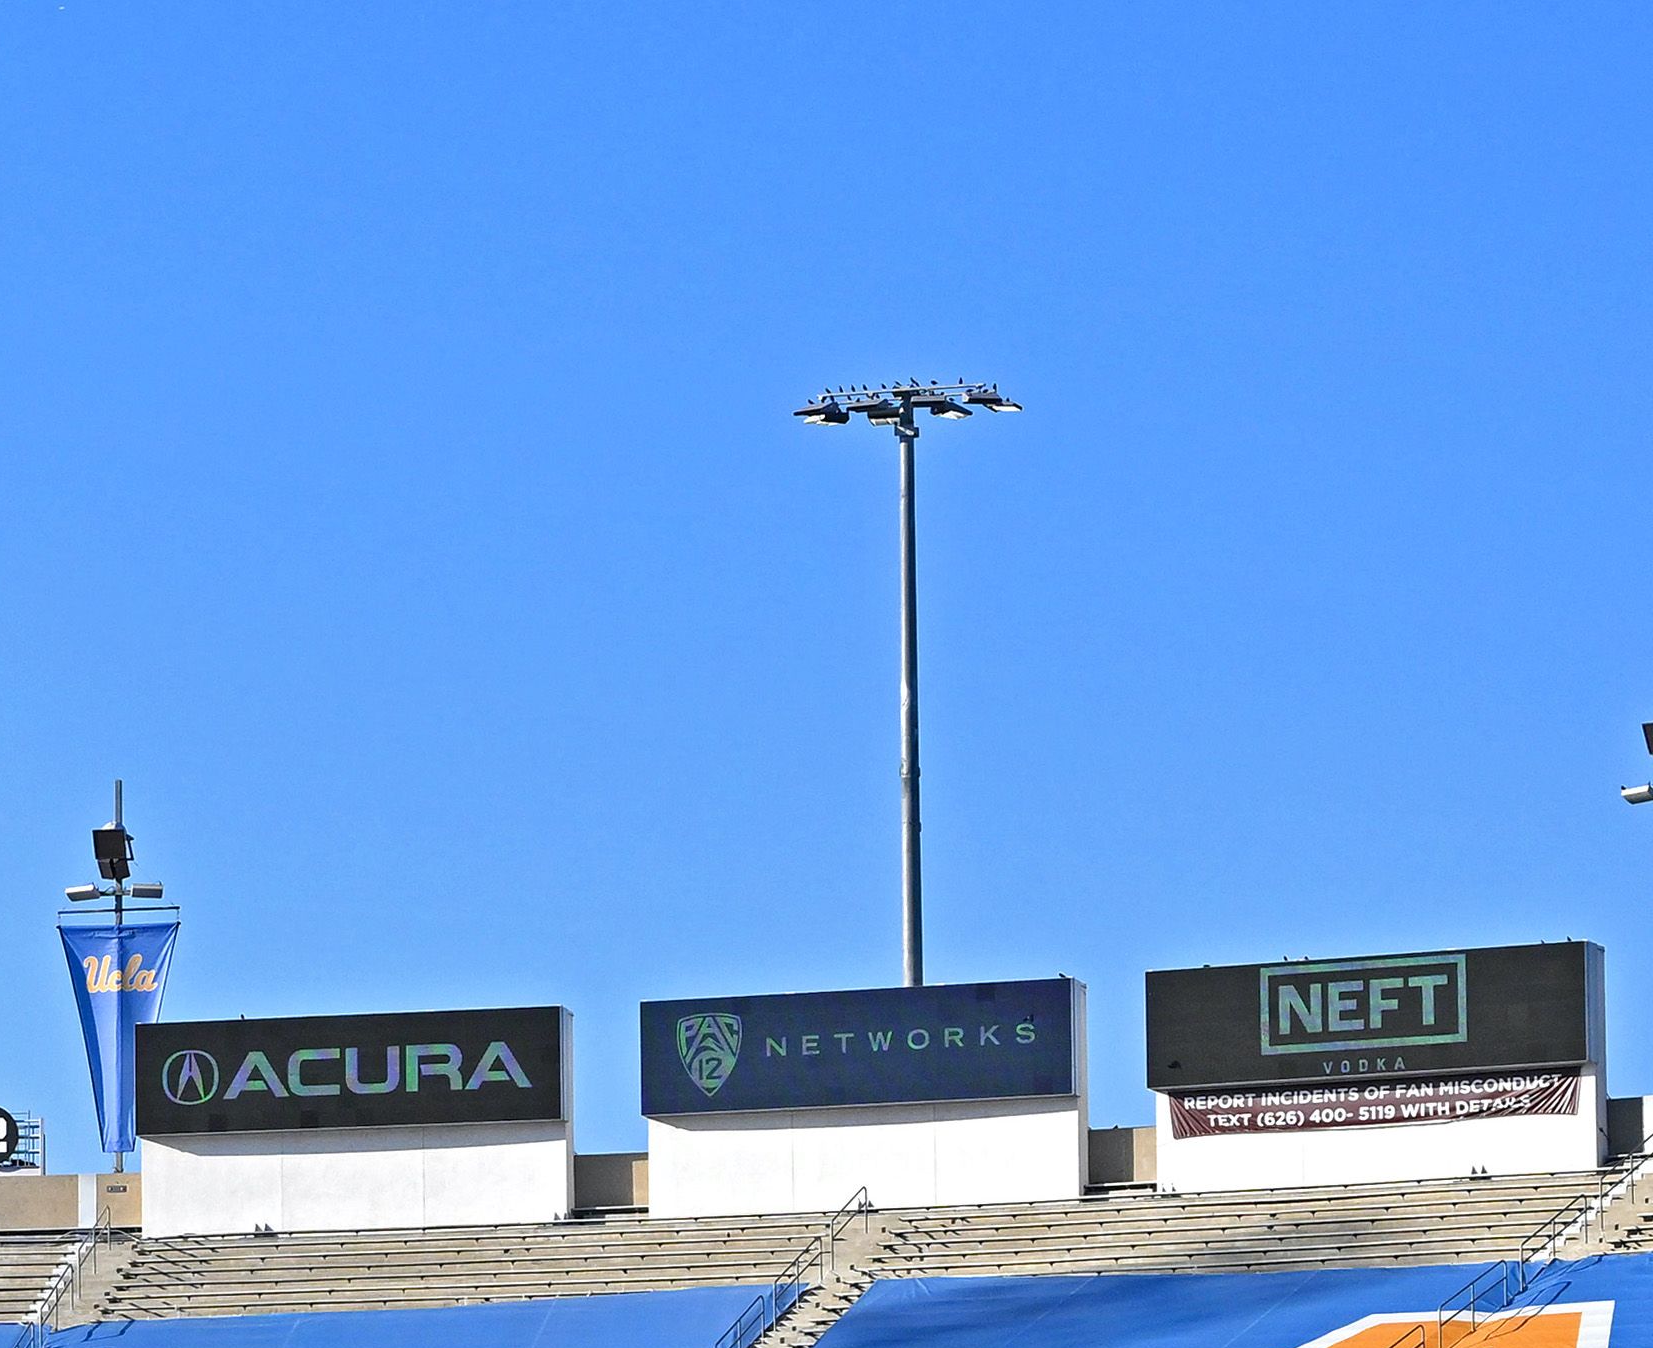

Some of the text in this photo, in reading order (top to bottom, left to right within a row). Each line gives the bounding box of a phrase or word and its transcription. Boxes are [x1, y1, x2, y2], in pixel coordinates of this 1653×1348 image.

[1277, 974, 1449, 1036] NEFT
[680, 1017, 739, 1064] PAC
[766, 1022, 1037, 1057] NETWORKS
[223, 1041, 533, 1100] ACURA
[699, 1057, 723, 1080] 12
[1323, 1057, 1407, 1075] VODKA
[1184, 1073, 1563, 1111] REPORT INCIDENTS OF FAN MISCONDUCT
[1207, 1113, 1252, 1129] TEXT
[1256, 1109, 1305, 1129] (626)
[1309, 1106, 1354, 1124] 400-
[1359, 1104, 1396, 1122] 5119
[1400, 1101, 1450, 1119] WITH
